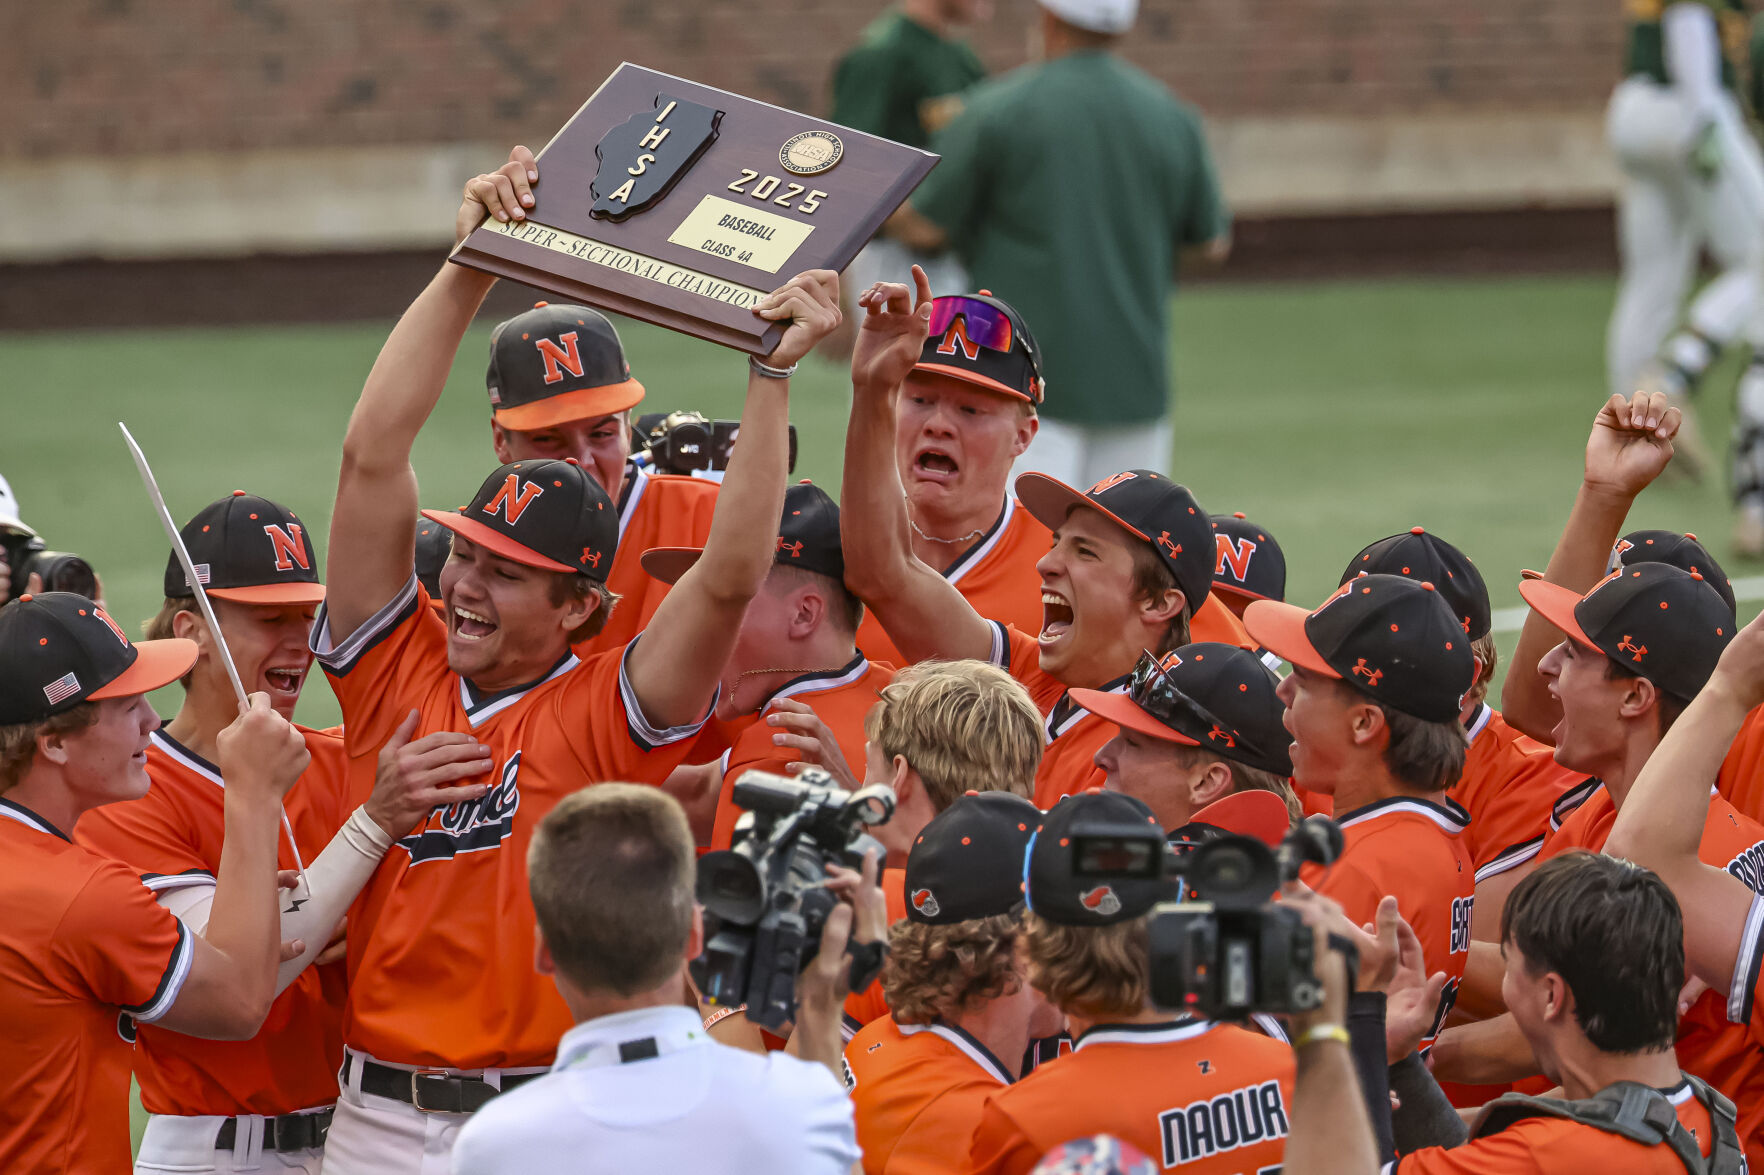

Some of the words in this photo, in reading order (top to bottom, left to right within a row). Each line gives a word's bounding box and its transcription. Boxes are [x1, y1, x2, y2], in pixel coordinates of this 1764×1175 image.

[781, 153, 824, 172] ASSOCIATION
[727, 168, 829, 214] 2025
[701, 239, 736, 257] CLASS
[737, 250, 754, 263] 4A
[718, 214, 777, 241] BASEBALL
[535, 331, 584, 385] N
[483, 473, 545, 526] N
[263, 522, 310, 571] N
[1215, 533, 1257, 582] N
[1158, 1079, 1290, 1169] NAOUR
